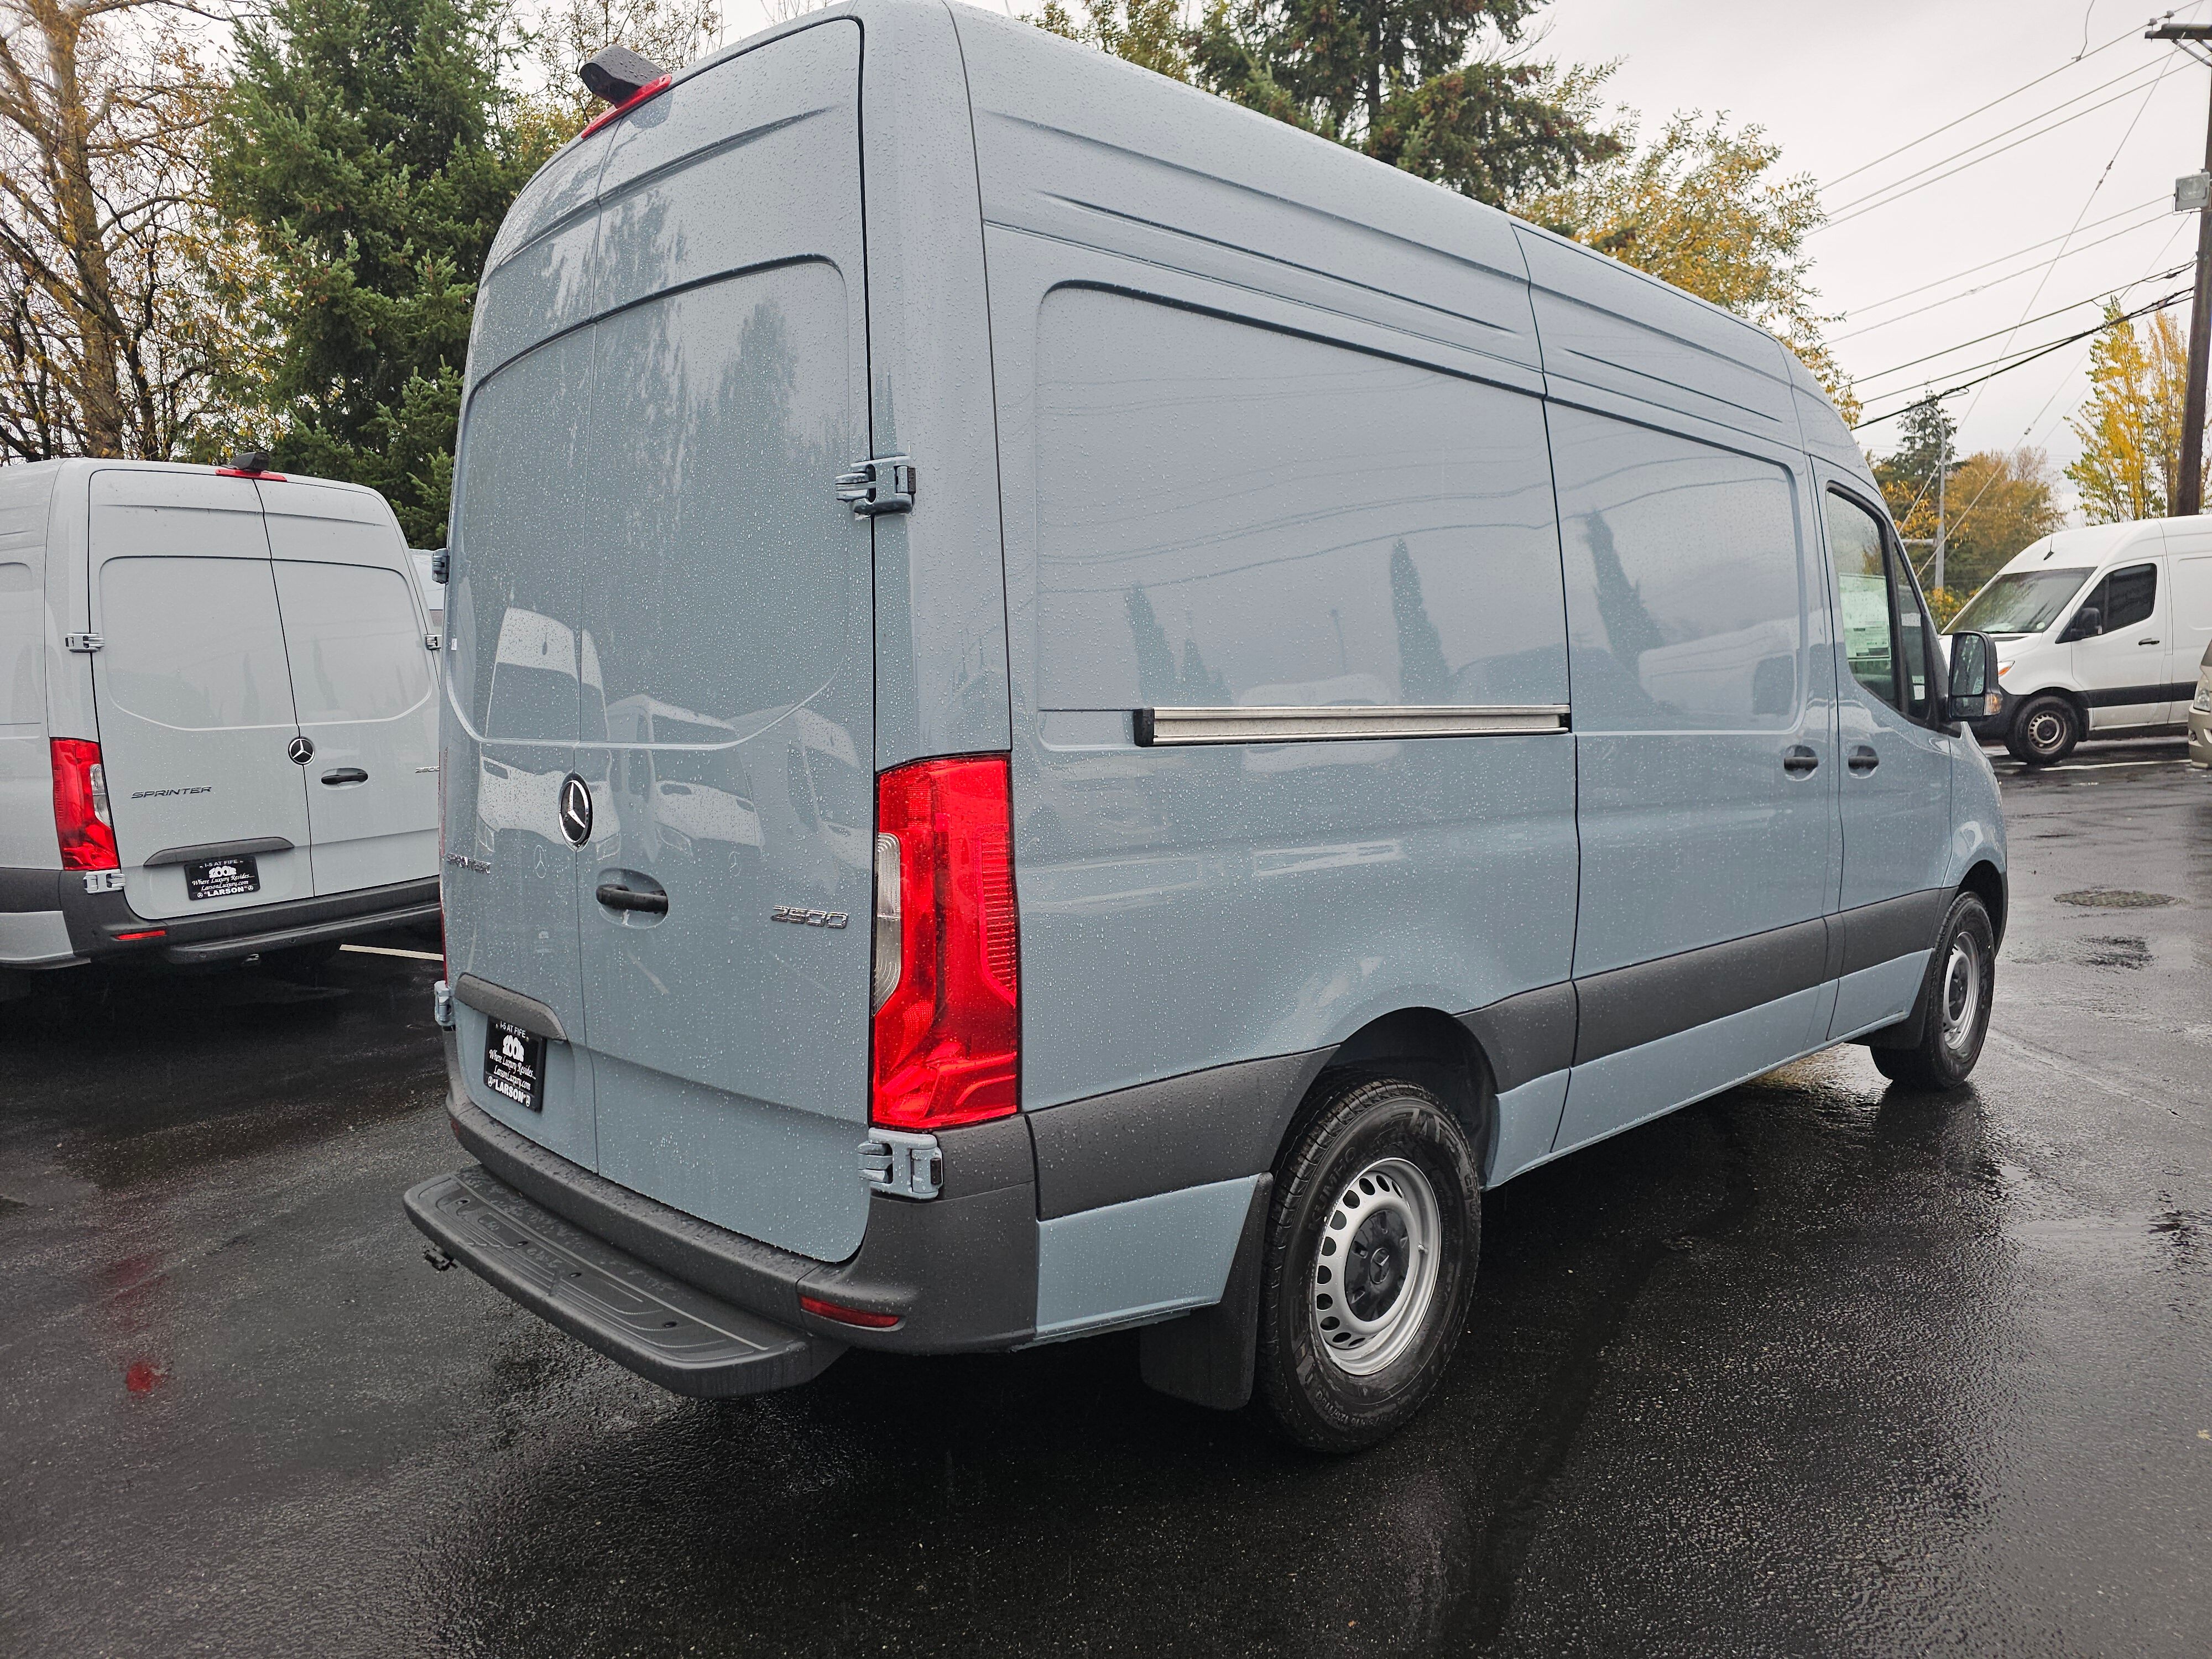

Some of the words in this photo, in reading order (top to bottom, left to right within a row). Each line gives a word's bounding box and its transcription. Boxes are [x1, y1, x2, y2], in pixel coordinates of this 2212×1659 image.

[131, 785, 212, 799] SPRINTER
[201, 880, 248, 891] LarsonLuxury.com
[207, 886, 244, 897] LARSON
[770, 905, 849, 928] 2500
[507, 1024, 513, 1033] AT
[514, 1027, 525, 1039] FIFE
[489, 1049, 502, 1063] Where
[502, 1055, 517, 1074] Luxury
[493, 1065, 531, 1091] LarsonLuxury.com
[495, 1079, 524, 1103] LARSON
